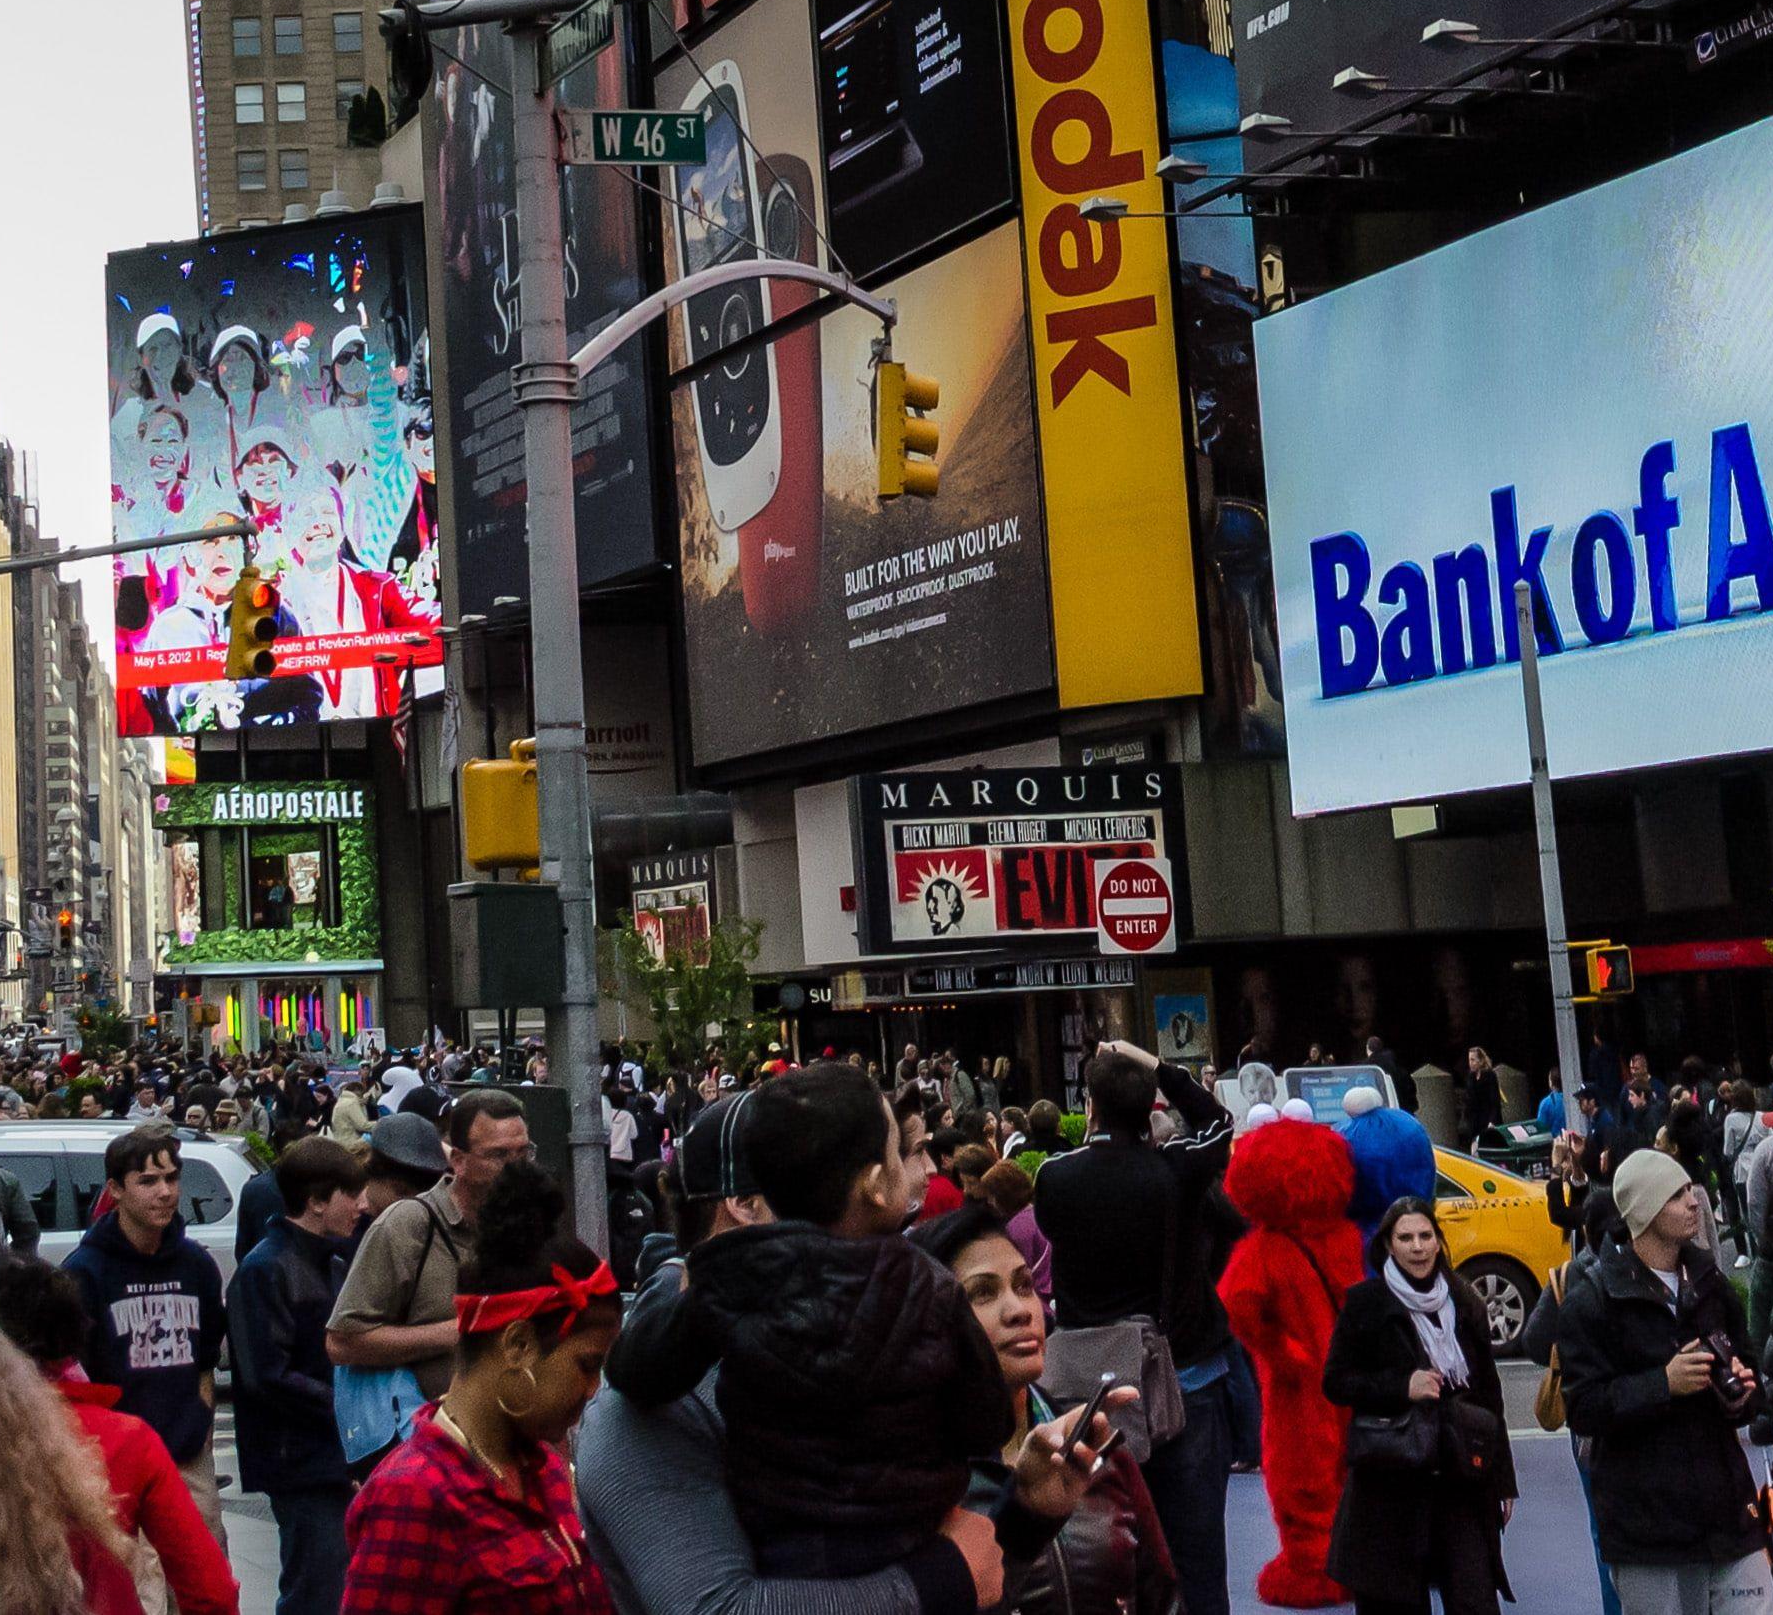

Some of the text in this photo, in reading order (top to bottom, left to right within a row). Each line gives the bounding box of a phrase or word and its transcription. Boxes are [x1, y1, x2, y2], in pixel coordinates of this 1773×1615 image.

[1247, 2, 1290, 40] UFC.COM
[602, 118, 696, 157] W 46 ST
[845, 516, 1021, 596] BUILT FOR THE WAY YOU PLAY.
[1310, 483, 1565, 698] Bank
[1572, 439, 1681, 647] of
[214, 786, 364, 819] AÉROPOSTALE
[882, 772, 1162, 809] MARQUIS
[903, 816, 1147, 848] RICKY MARTIN MICHAEL CERVERIS
[632, 855, 709, 884] MARQUIS
[1110, 878, 1157, 893] DO NOT
[1116, 920, 1157, 934] ENTER
